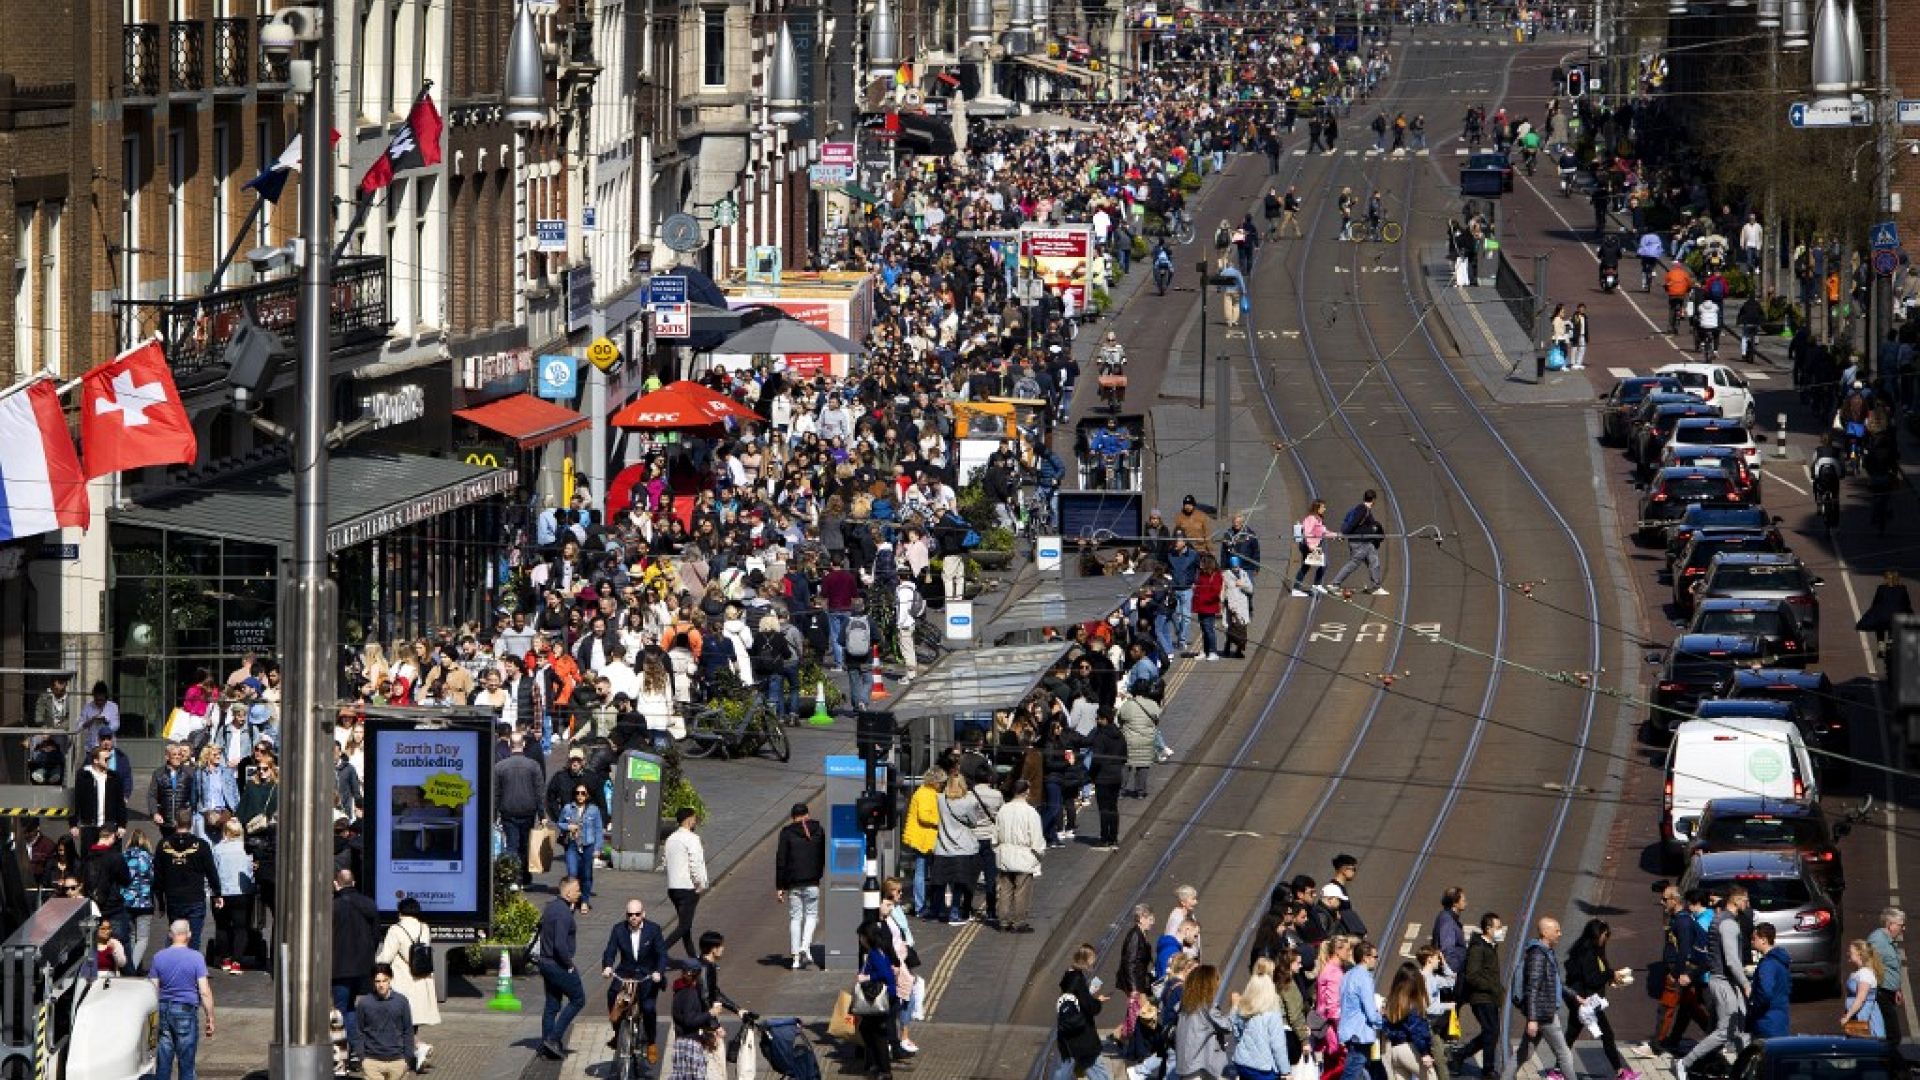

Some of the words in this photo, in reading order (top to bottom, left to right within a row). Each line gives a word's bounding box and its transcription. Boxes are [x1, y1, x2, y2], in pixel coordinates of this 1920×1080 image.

[637, 411, 680, 423] KFC
[1308, 621, 1442, 642] BUS
[395, 742, 432, 755] Earth
[434, 743, 461, 757] Day
[391, 756, 464, 771] aanbieding
